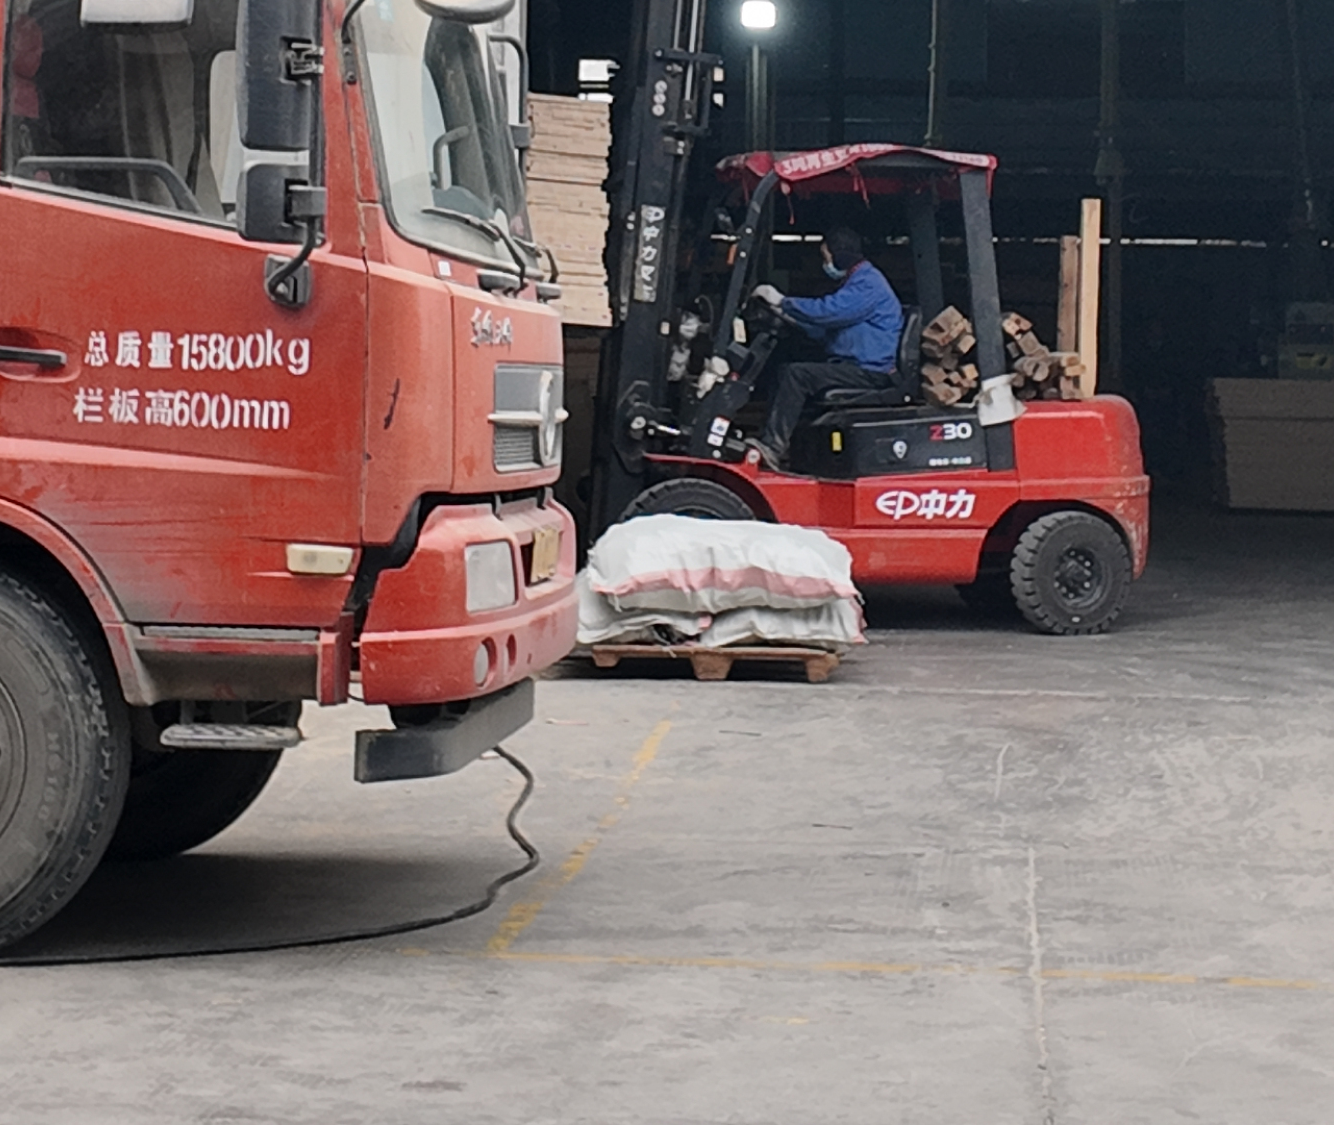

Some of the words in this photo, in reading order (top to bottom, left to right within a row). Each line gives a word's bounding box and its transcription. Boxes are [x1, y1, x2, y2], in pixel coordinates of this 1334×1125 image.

[84, 328, 310, 376] 总质量15800kg
[73, 386, 290, 430] 栏板高600mm
[929, 422, 973, 441] Z30
